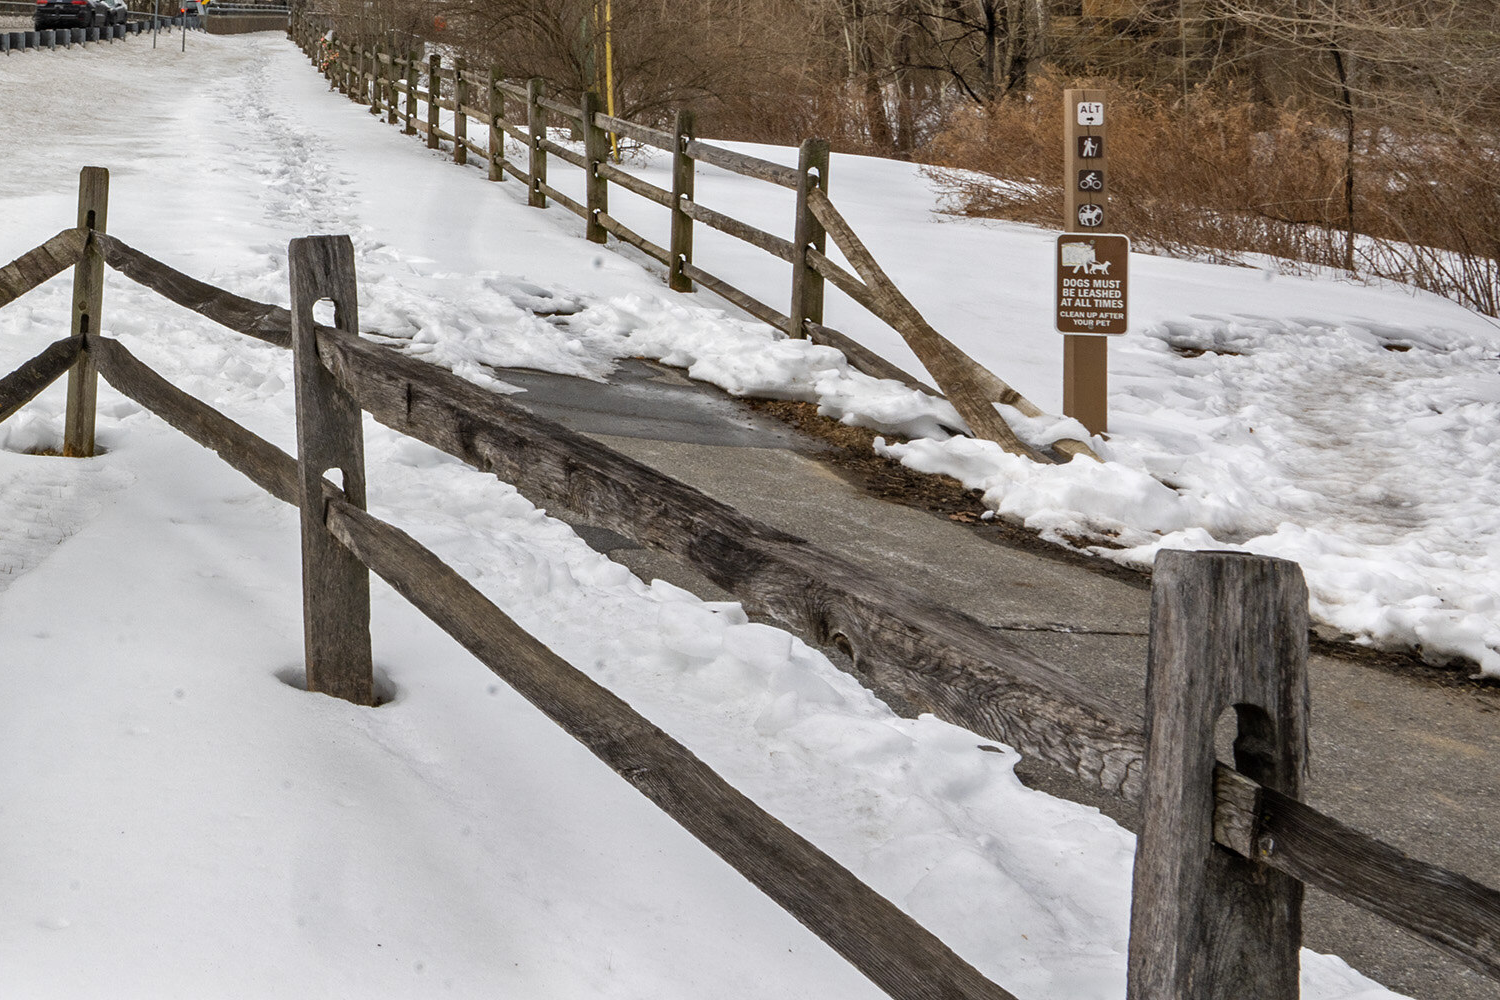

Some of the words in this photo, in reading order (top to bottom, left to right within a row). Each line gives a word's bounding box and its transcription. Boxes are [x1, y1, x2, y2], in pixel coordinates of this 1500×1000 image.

[1080, 105, 1100, 113] ALT
[1063, 278, 1090, 287] DOGS
[1093, 279, 1121, 288] MUST
[1063, 288, 1075, 297] BE
[1078, 289, 1122, 298] LEASHED
[1060, 298, 1073, 306] AT
[1074, 299, 1092, 307] ALL
[1094, 299, 1124, 309] TIMES
